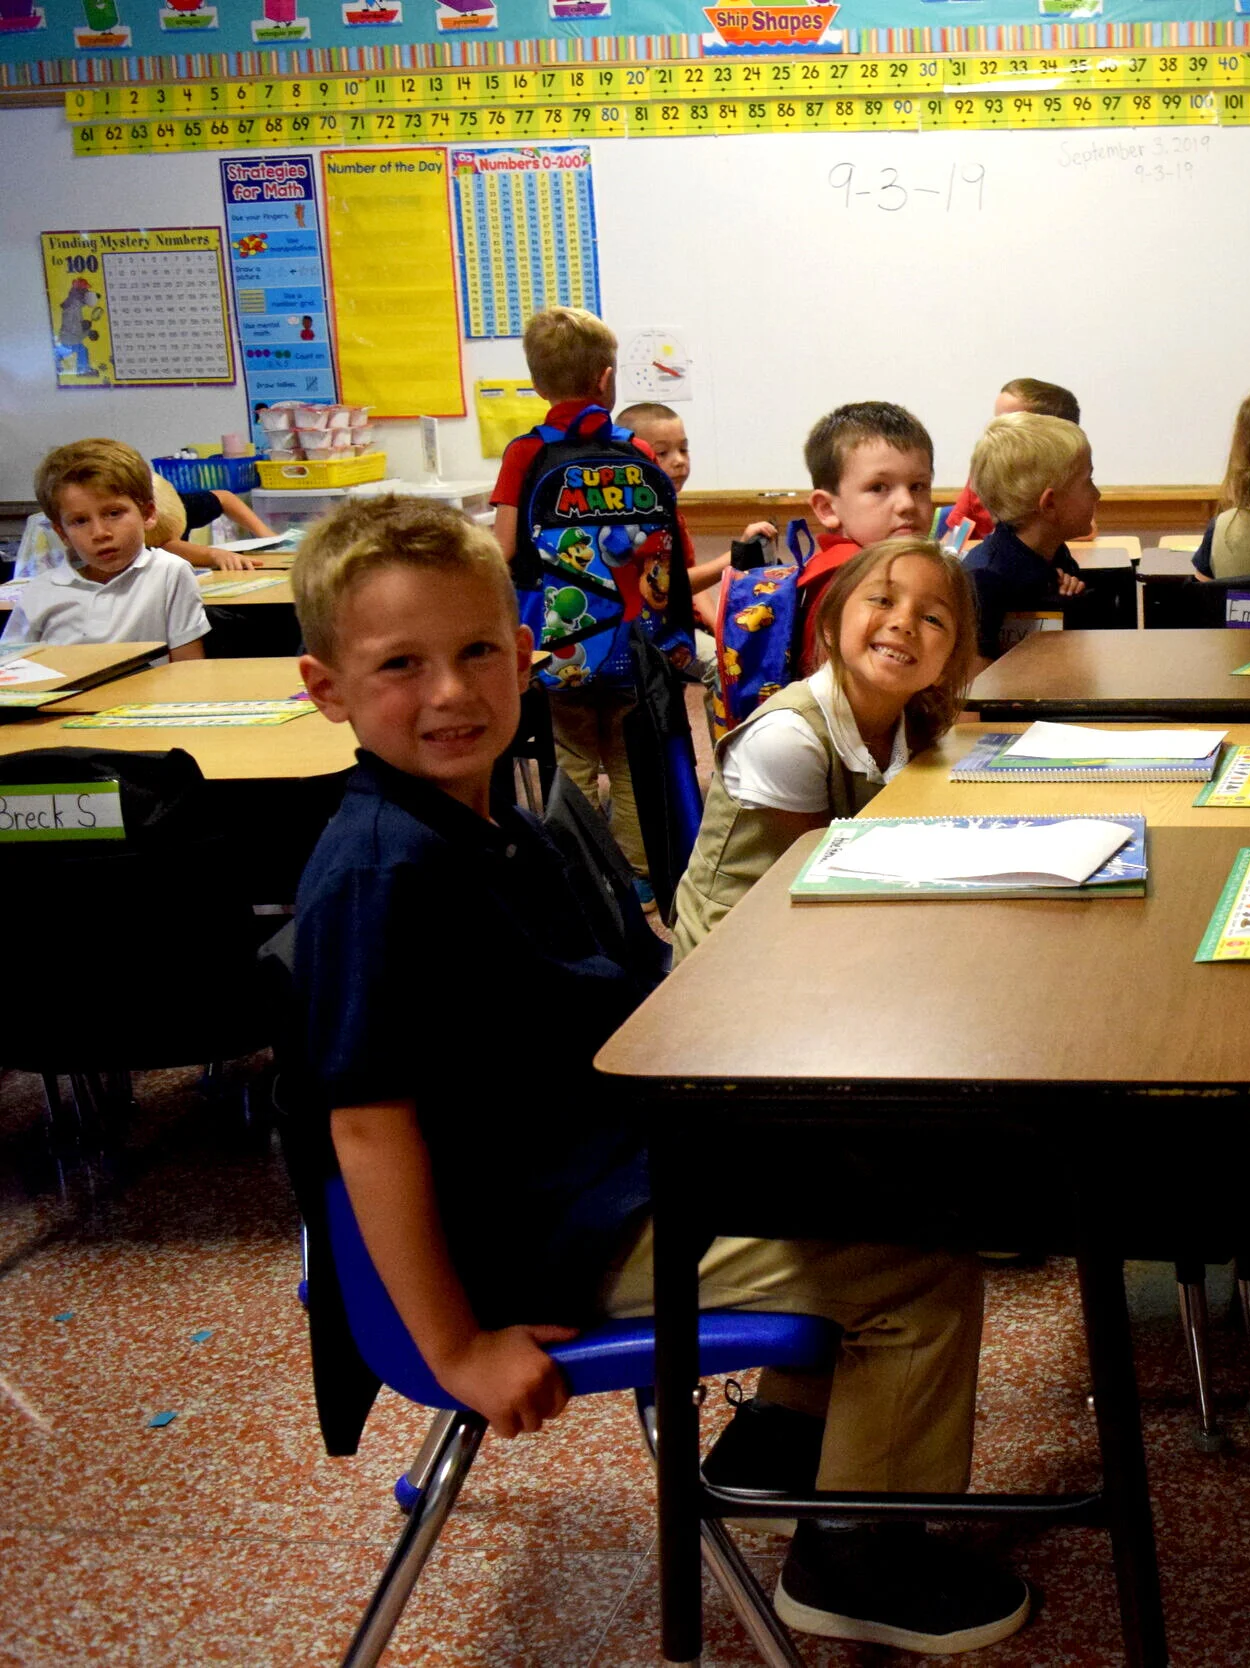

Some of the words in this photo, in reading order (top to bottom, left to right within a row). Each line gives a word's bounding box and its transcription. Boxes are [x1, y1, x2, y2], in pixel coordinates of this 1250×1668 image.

[716, 11, 749, 30] Ship
[751, 10, 824, 34] Shapes
[75, 93, 85, 107] 0
[129, 90, 138, 105] 2
[156, 88, 166, 104] 3
[183, 88, 192, 102] 4
[210, 86, 219, 101] 5
[237, 86, 246, 100] 6
[264, 84, 274, 99] 7
[292, 83, 301, 98] 8
[319, 82, 329, 97] 9
[344, 81, 359, 95] 10
[375, 79, 385, 94] 11
[401, 78, 415, 93] 12
[429, 77, 443, 92] 13
[457, 77, 470, 91] 14
[486, 75, 500, 90] 15
[514, 75, 527, 89] 16
[542, 73, 556, 88] 17
[571, 72, 584, 87] 18
[599, 71, 613, 86] 19
[626, 70, 644, 85] 20
[658, 69, 672, 84] 21
[685, 68, 703, 83] 22
[714, 67, 732, 82] 23
[743, 66, 761, 81] 24
[772, 66, 791, 81] 25
[801, 65, 820, 80] 26
[830, 64, 849, 79] 27
[860, 63, 878, 78] 28
[889, 63, 908, 78] 29
[919, 62, 937, 77] 30
[952, 61, 966, 76] 31
[980, 61, 997, 74] 32
[1128, 58, 1147, 73] 37
[1159, 57, 1177, 72] 38
[1189, 56, 1208, 72] 39
[1218, 56, 1238, 71] 40
[479, 158, 540, 171] Numbers
[542, 155, 581, 169] 0-200
[1059, 141, 1145, 167] September
[1172, 136, 1210, 152] 2019
[228, 163, 306, 182] Strategies
[327, 160, 377, 174] Number
[380, 160, 392, 173] of
[395, 160, 415, 173] the
[419, 160, 442, 174] Day
[233, 185, 260, 199] for
[264, 183, 304, 198] Math
[829, 162, 985, 211] 9-3-19
[49, 236, 97, 252] Finding
[100, 235, 150, 251] Mystery
[155, 234, 210, 246] Numbers
[52, 256, 63, 266] to
[65, 254, 99, 273] 100
[565, 465, 642, 488] SUPER
[557, 485, 656, 513] MARIO
[0, 794, 64, 830] Breck
[77, 793, 97, 828] S
